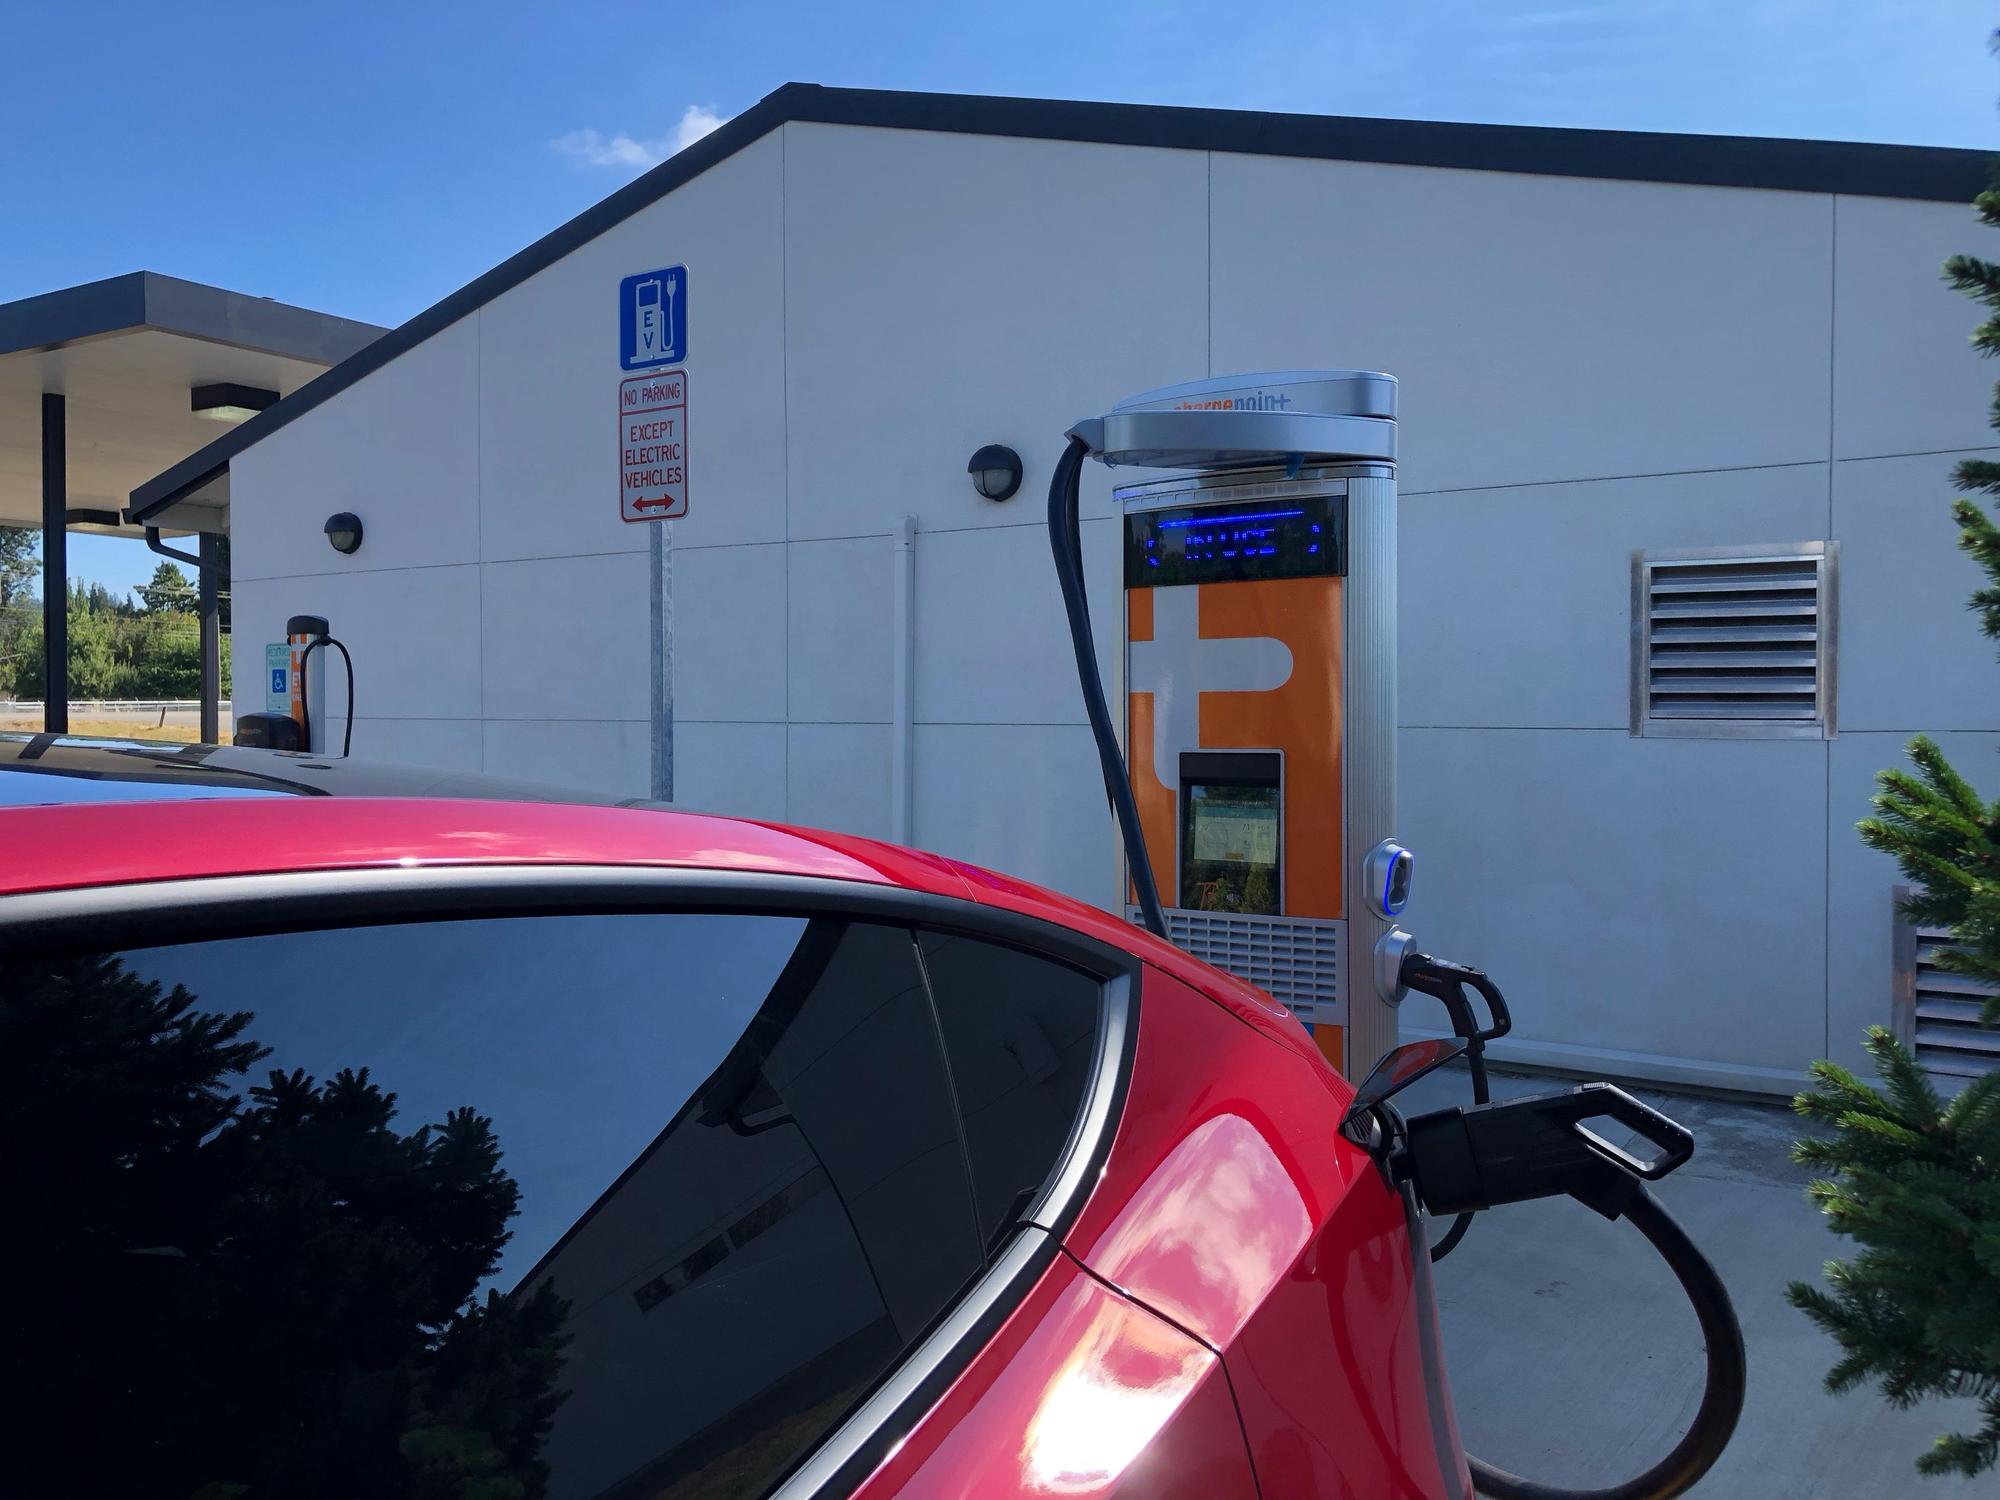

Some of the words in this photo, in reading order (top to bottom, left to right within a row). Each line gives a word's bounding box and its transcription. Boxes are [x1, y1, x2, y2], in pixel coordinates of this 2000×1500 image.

[624, 389, 638, 406] NO
[642, 382, 681, 404] PARKING
[1174, 390, 1292, 411] repoint
[630, 420, 675, 442] EXCEPT
[625, 443, 681, 466] ELECTRIC
[624, 466, 682, 489] VEHICLES
